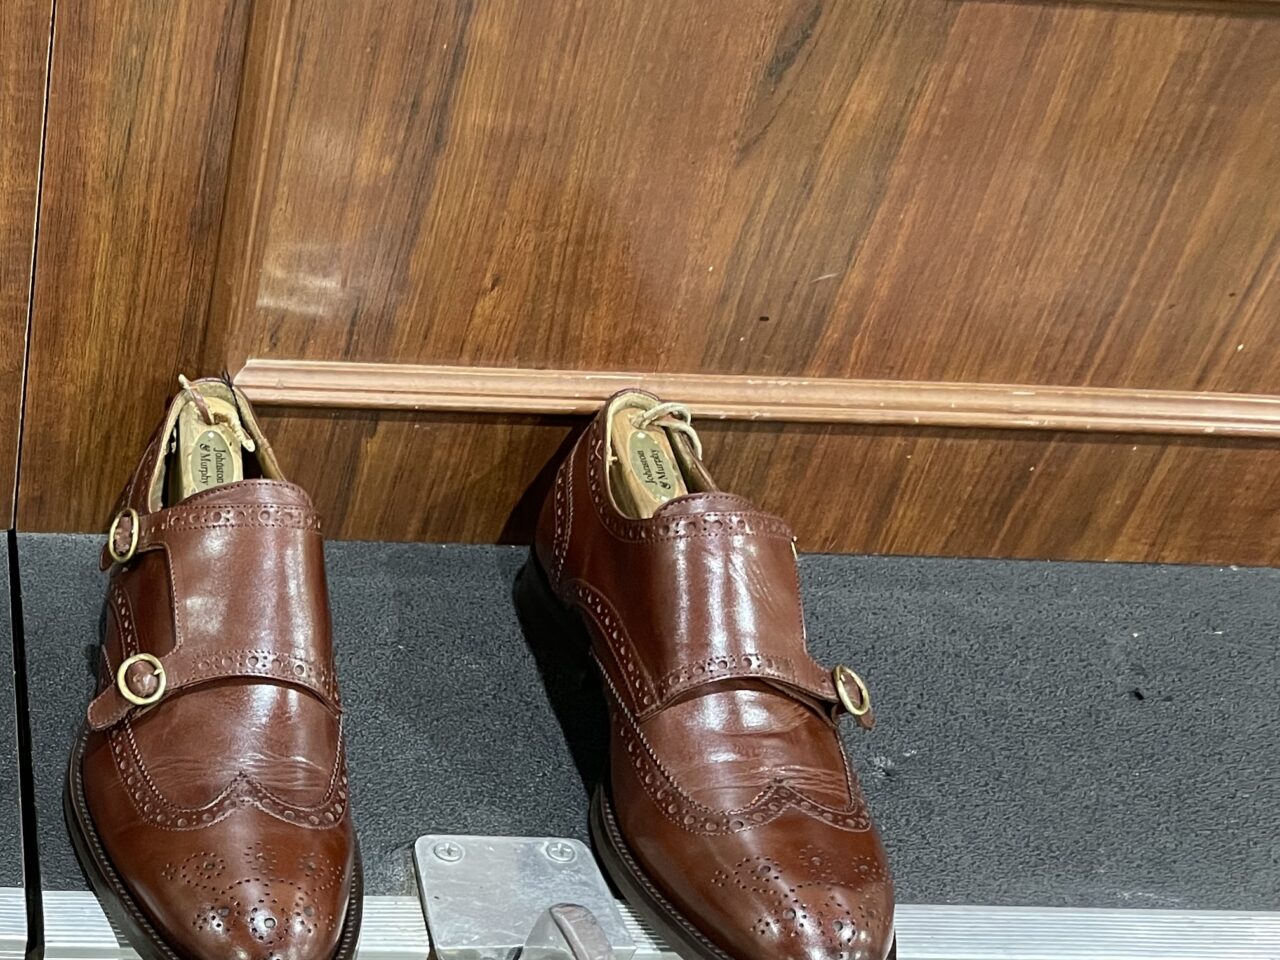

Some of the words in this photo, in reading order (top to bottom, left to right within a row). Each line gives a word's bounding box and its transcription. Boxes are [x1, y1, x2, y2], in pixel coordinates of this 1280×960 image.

[199, 443, 210, 452] &
[198, 453, 211, 485] Murphy
[213, 447, 226, 483] Johnston
[637, 450, 657, 485] Johnston
[650, 449, 668, 480] Murphy
[660, 481, 671, 489] &
